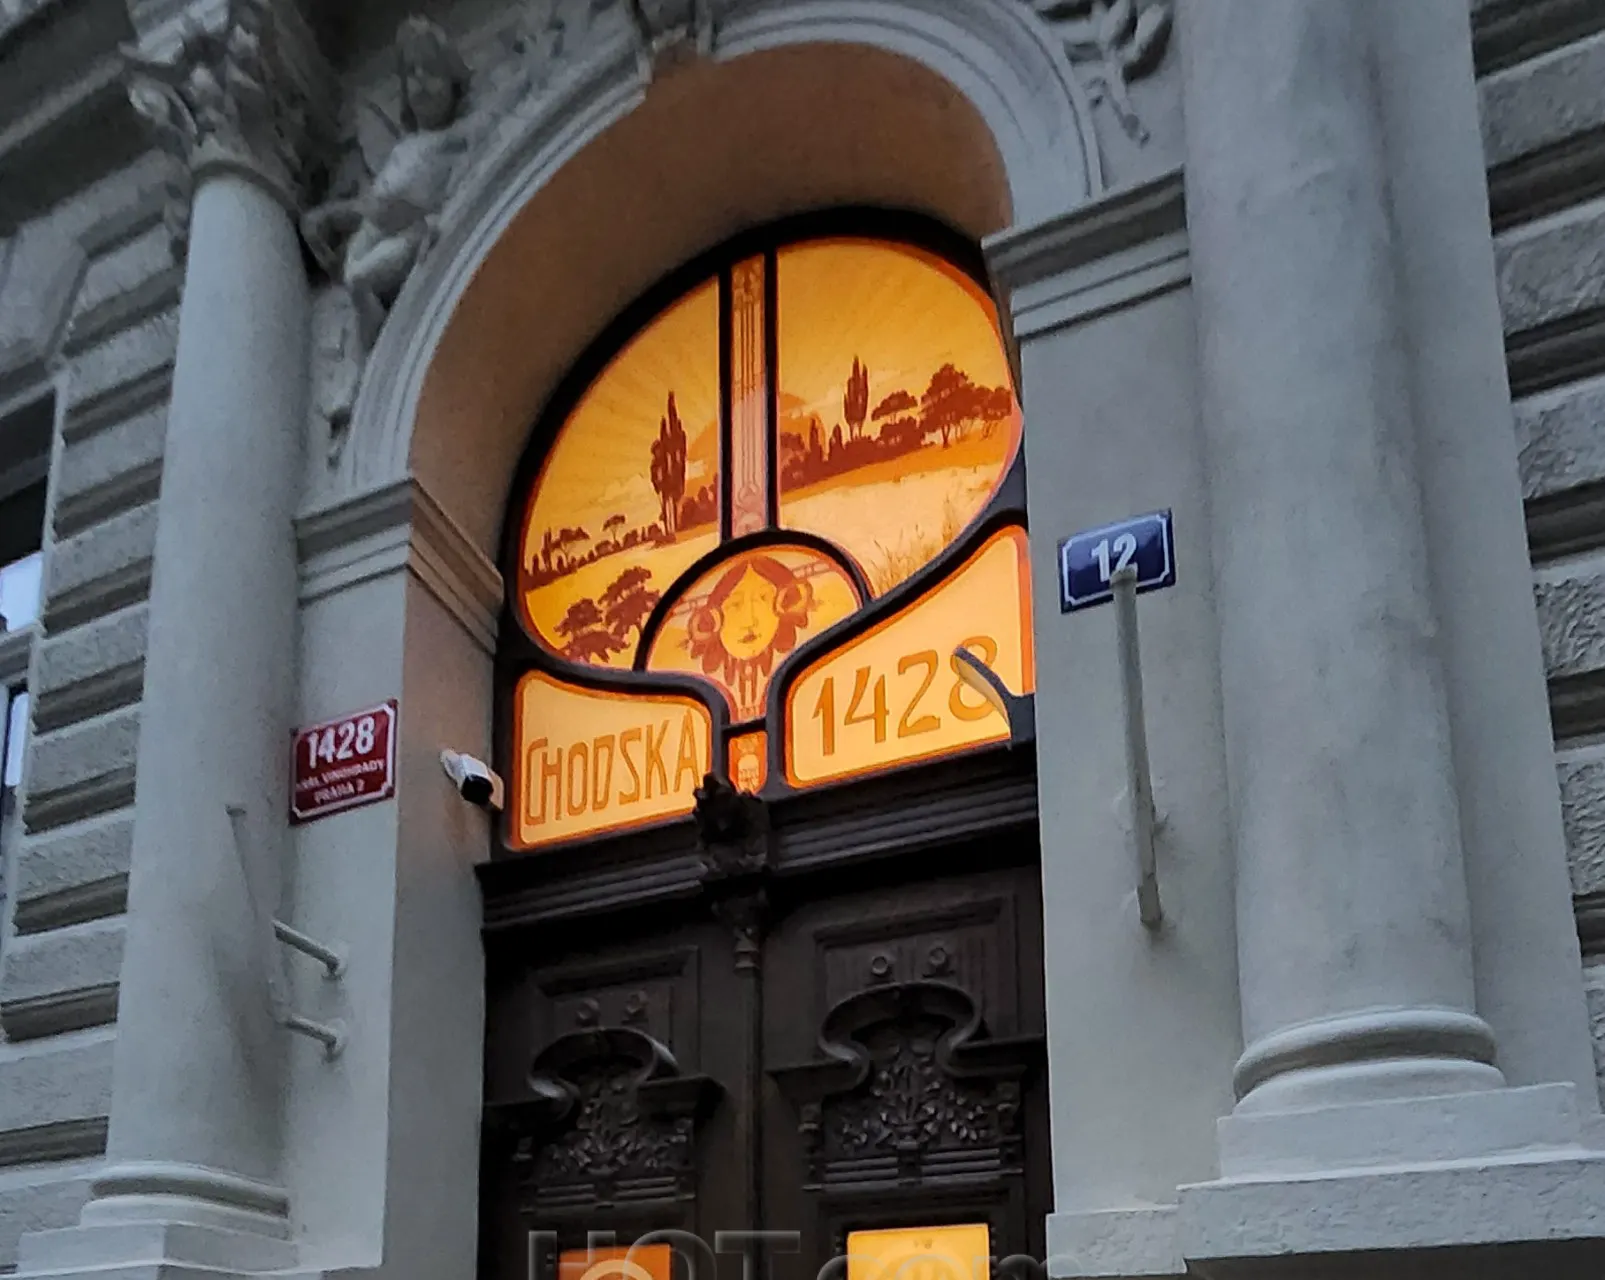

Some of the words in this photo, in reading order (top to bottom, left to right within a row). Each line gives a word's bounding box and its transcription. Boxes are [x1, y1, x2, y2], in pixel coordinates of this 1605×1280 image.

[1091, 533, 1138, 582] 12
[811, 636, 998, 757] 1428
[308, 716, 375, 769] 1428
